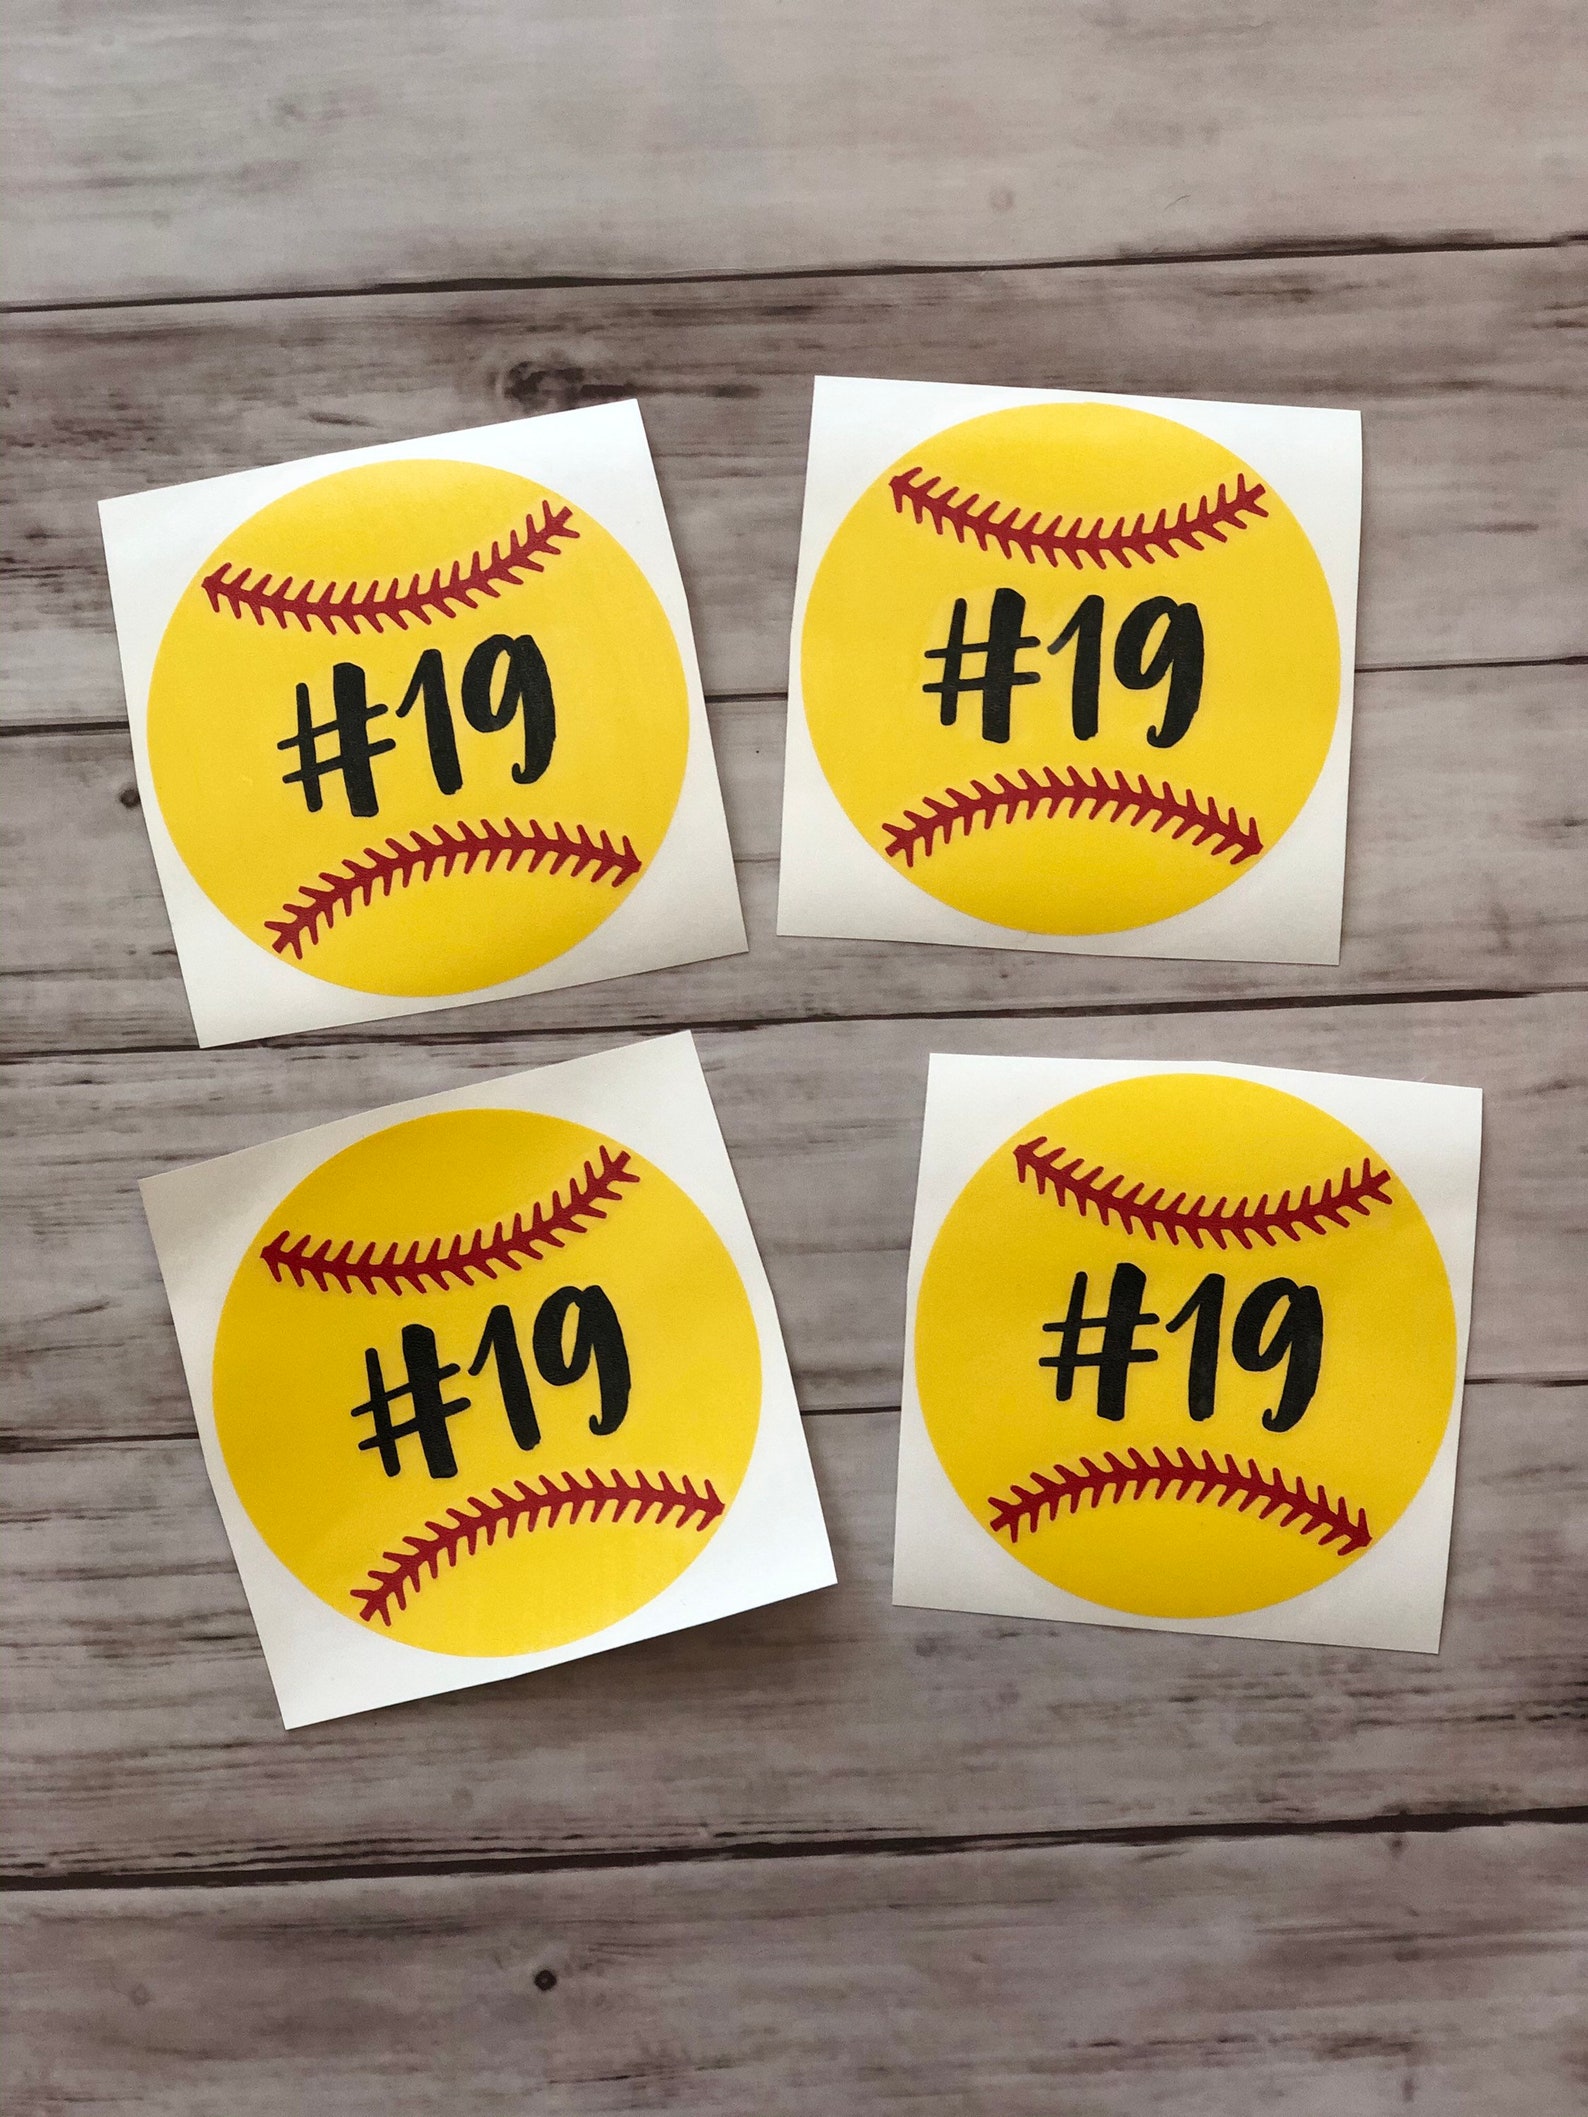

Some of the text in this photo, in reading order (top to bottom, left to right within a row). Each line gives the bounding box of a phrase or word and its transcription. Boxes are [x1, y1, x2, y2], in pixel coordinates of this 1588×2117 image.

[277, 634, 556, 817] #19
[923, 588, 1204, 748] #19
[351, 1285, 631, 1479] #19
[1039, 1263, 1323, 1432] #19
